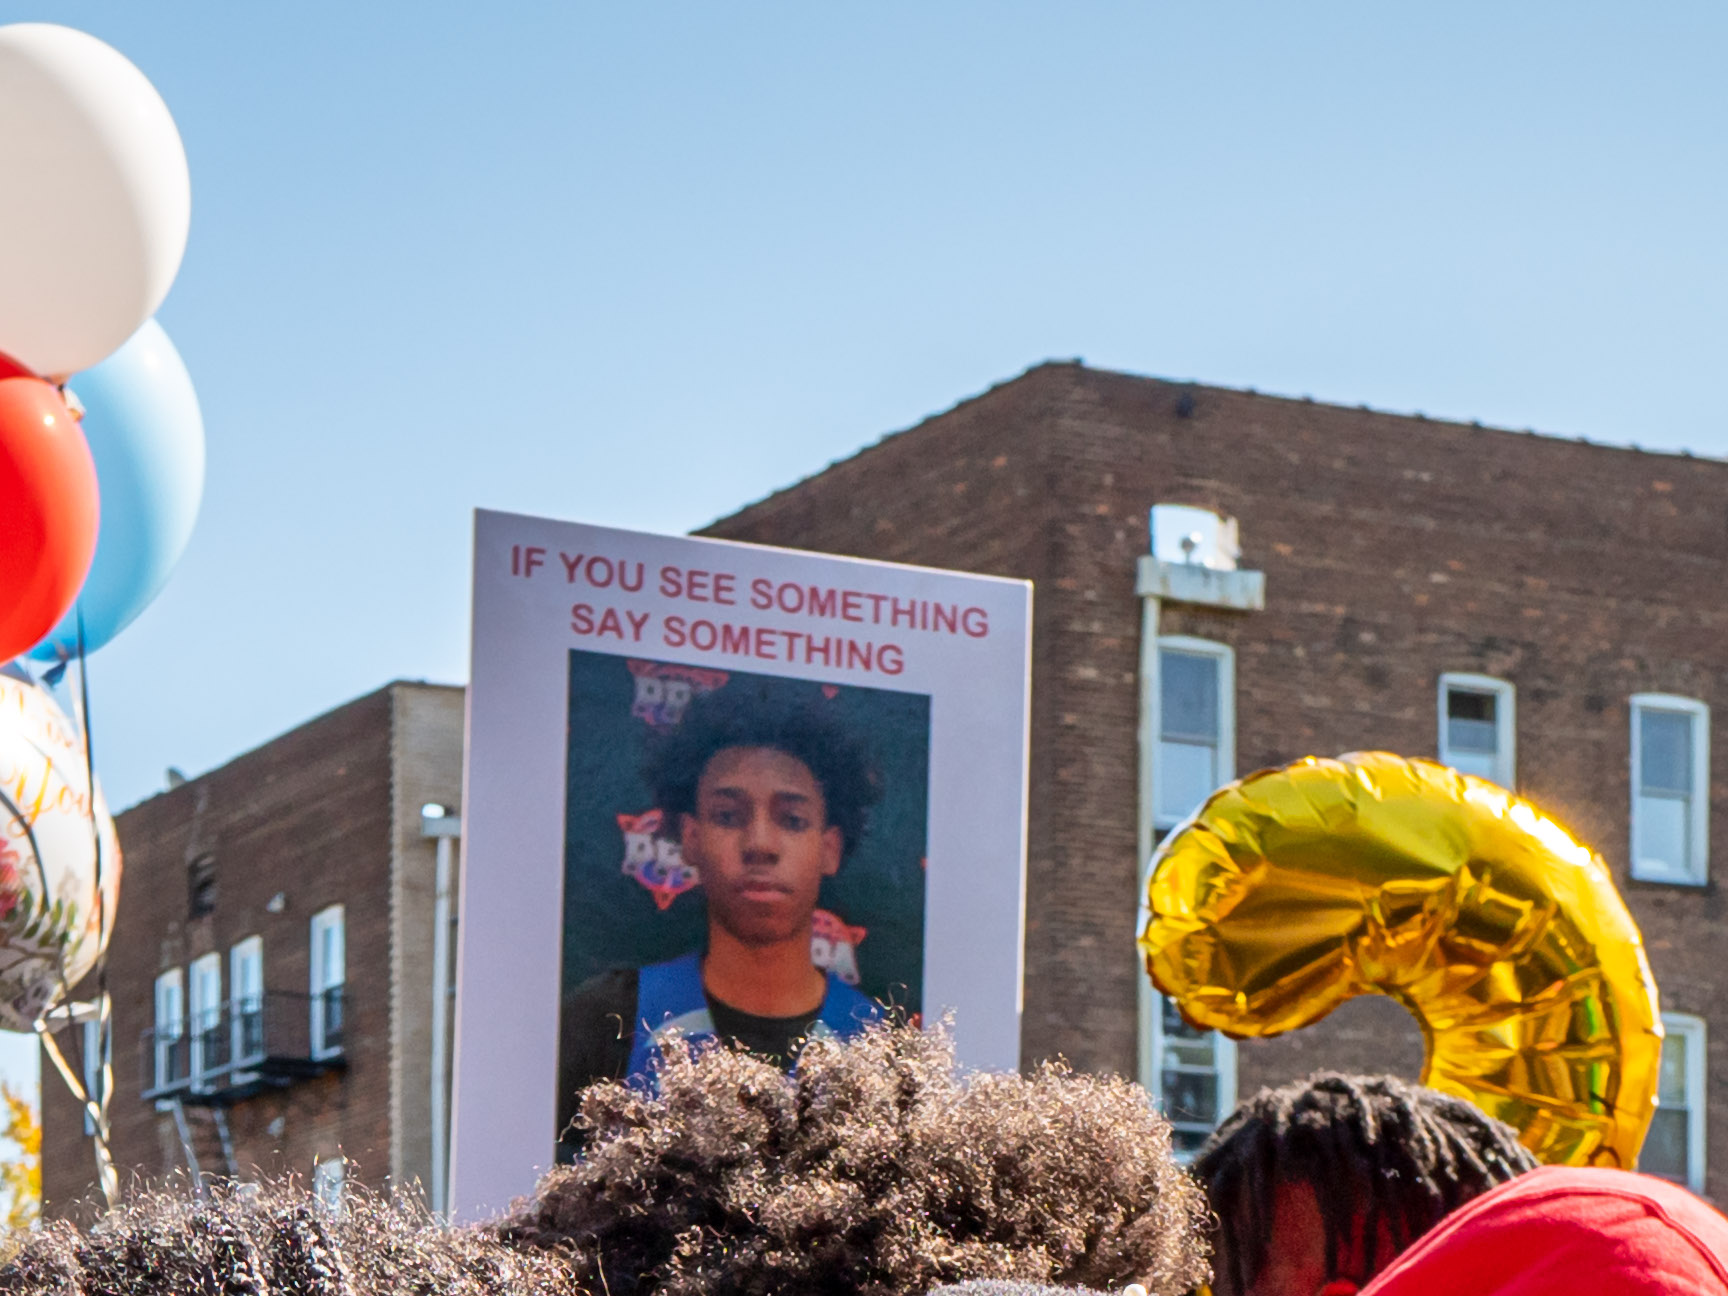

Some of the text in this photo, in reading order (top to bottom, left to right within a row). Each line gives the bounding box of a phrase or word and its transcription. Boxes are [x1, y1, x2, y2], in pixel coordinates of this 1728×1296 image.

[511, 545, 990, 638] IF YOU SEE SOMETHING
[571, 603, 905, 676] SAY SOMETHING
